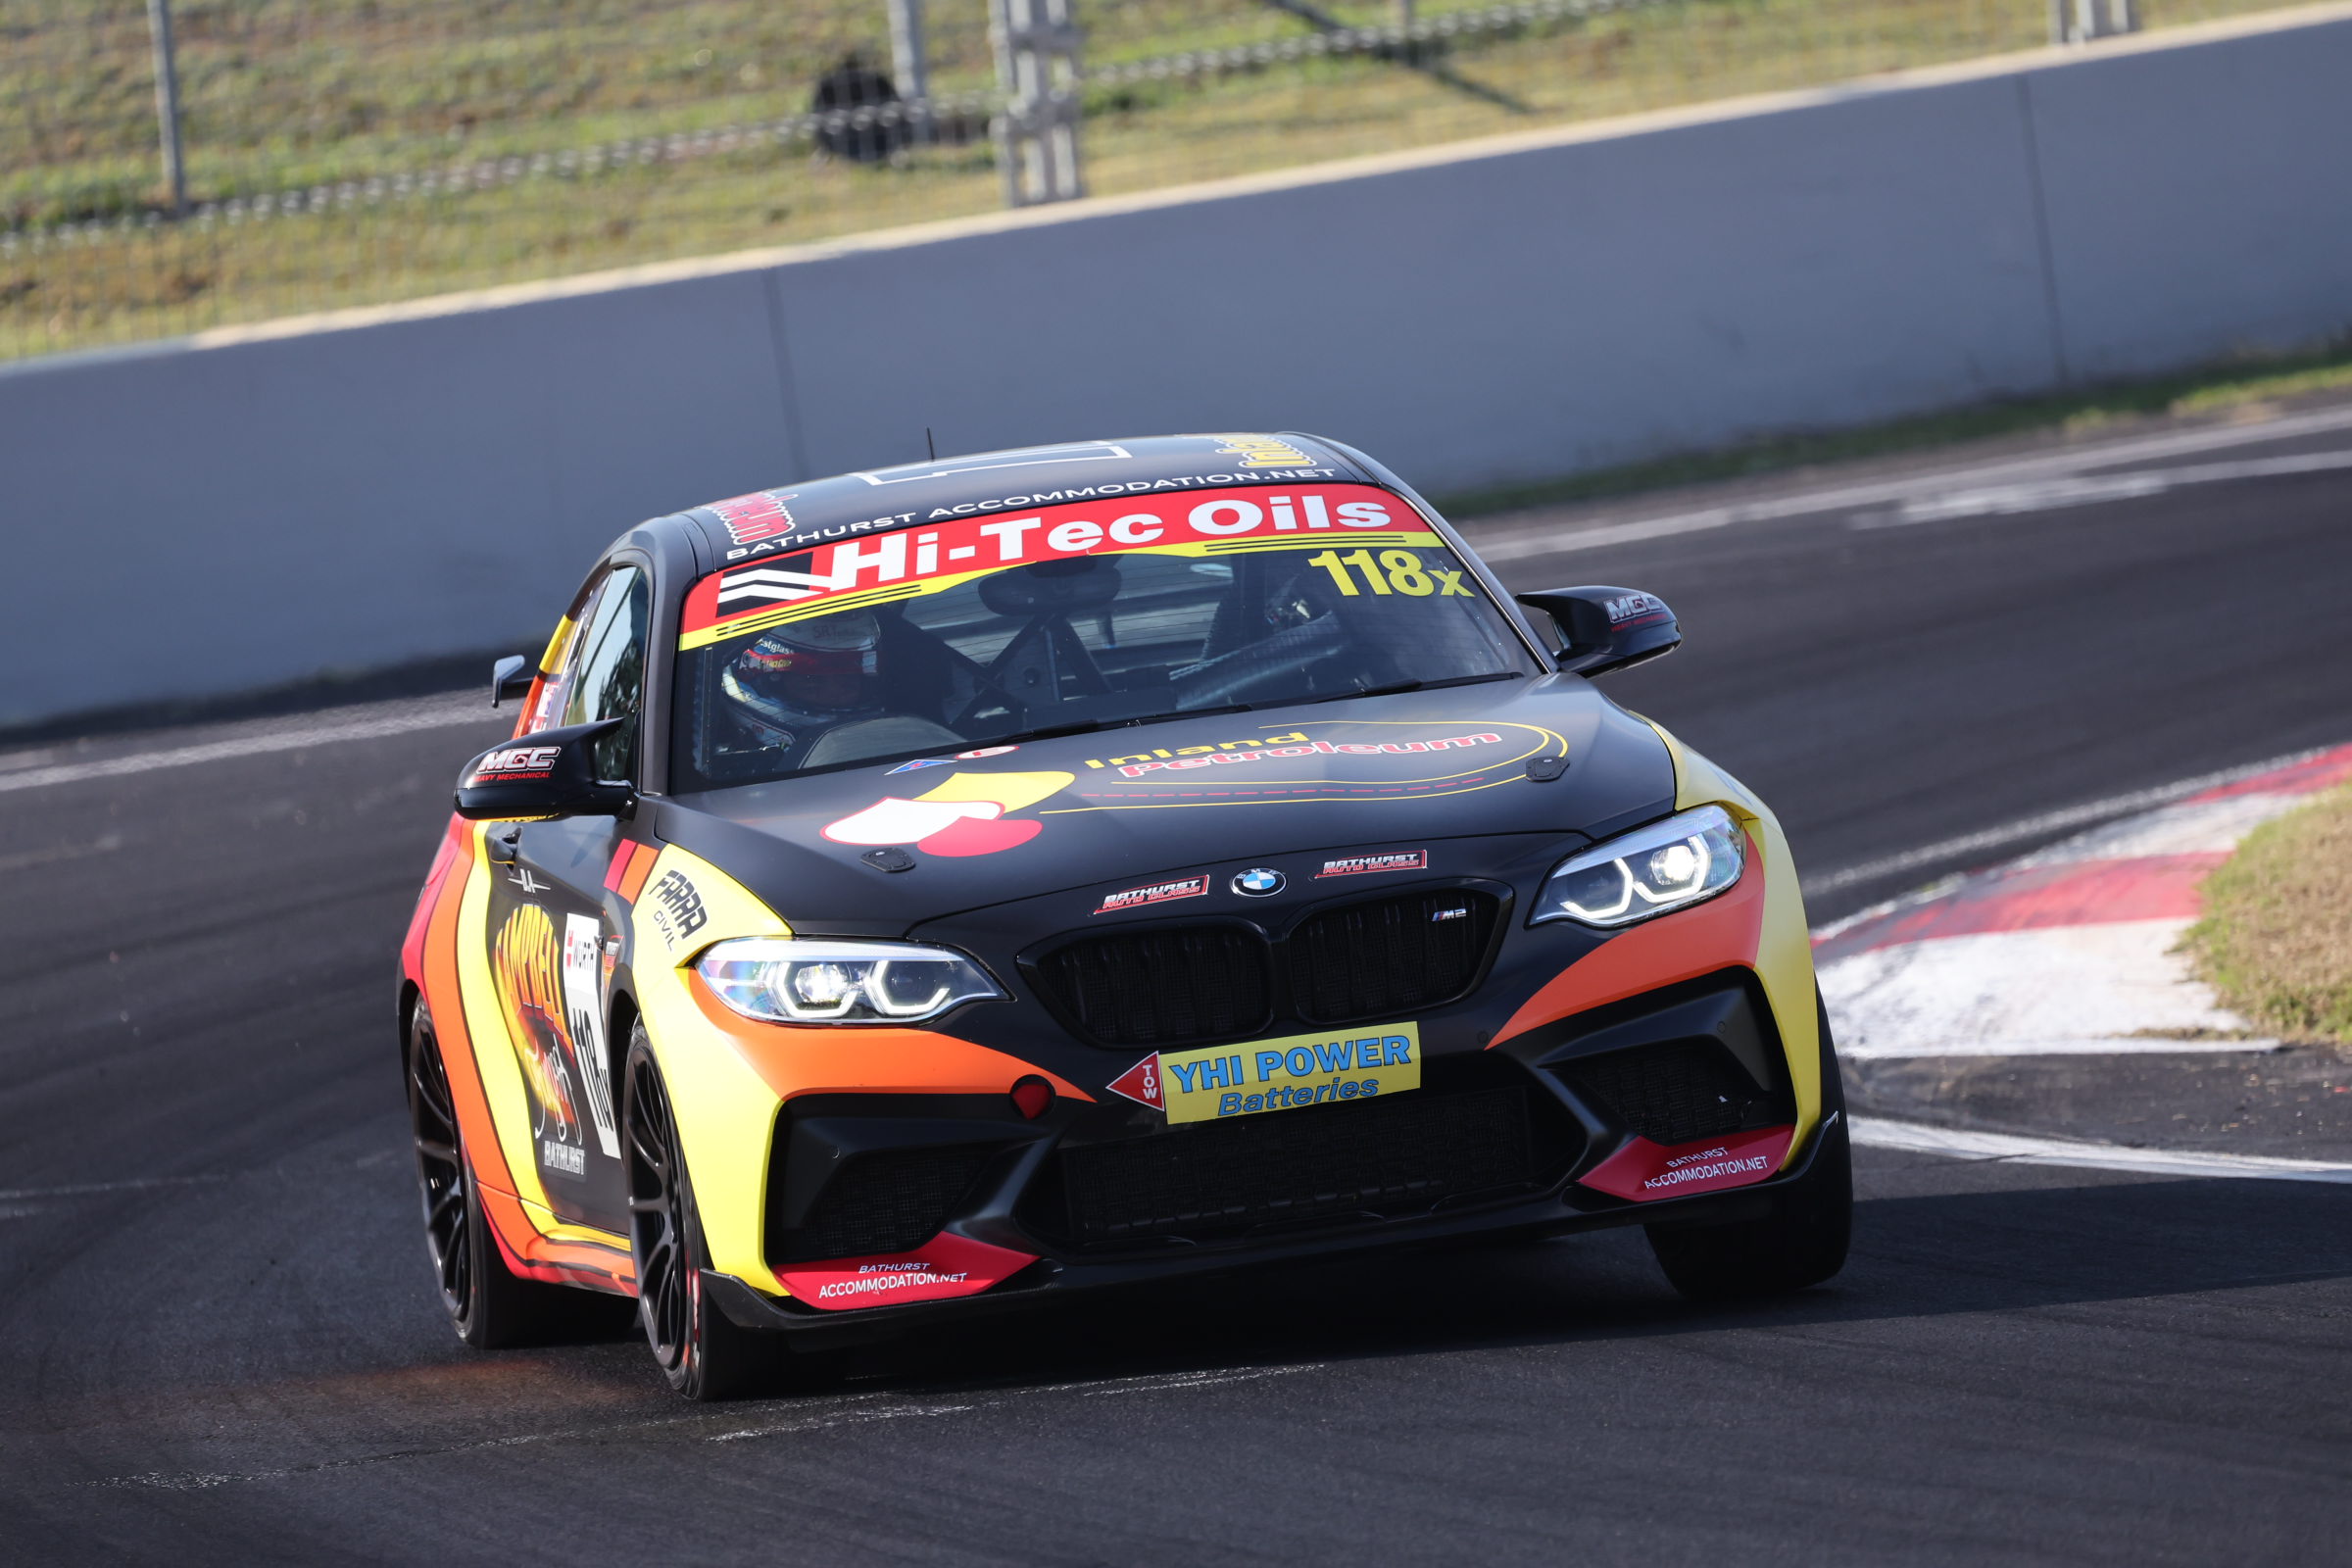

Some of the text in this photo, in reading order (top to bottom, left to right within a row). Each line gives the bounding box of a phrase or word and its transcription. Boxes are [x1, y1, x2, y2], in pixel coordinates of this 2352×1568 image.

[726, 468, 1335, 561] BATHURST ACCOMMODATION.NET
[829, 495, 1392, 591] Hi-Tec Oils
[1085, 732, 1309, 768] Inland
[1117, 733, 1502, 778] Petroleum
[497, 771, 551, 781] MECHANICAL
[1323, 859, 1420, 874] AUTO GLASS
[1324, 854, 1418, 869] BATHURST
[1102, 886, 1200, 909] AUTO GLASS
[1103, 880, 1200, 904] BATHURST
[654, 910, 675, 953] CIVIL
[1438, 908, 1467, 922] M2
[1142, 1064, 1158, 1100] TOW
[1168, 1035, 1411, 1094] YHI POWER
[1217, 1077, 1380, 1117] Batteries
[544, 1140, 586, 1176] BATHURST
[1644, 1155, 1768, 1190] ACCOMMODATION.NET
[1667, 1147, 1729, 1168] BATHURST
[818, 1272, 967, 1299] ACCOMMODATION.NET
[858, 1262, 931, 1274] BATHURST
